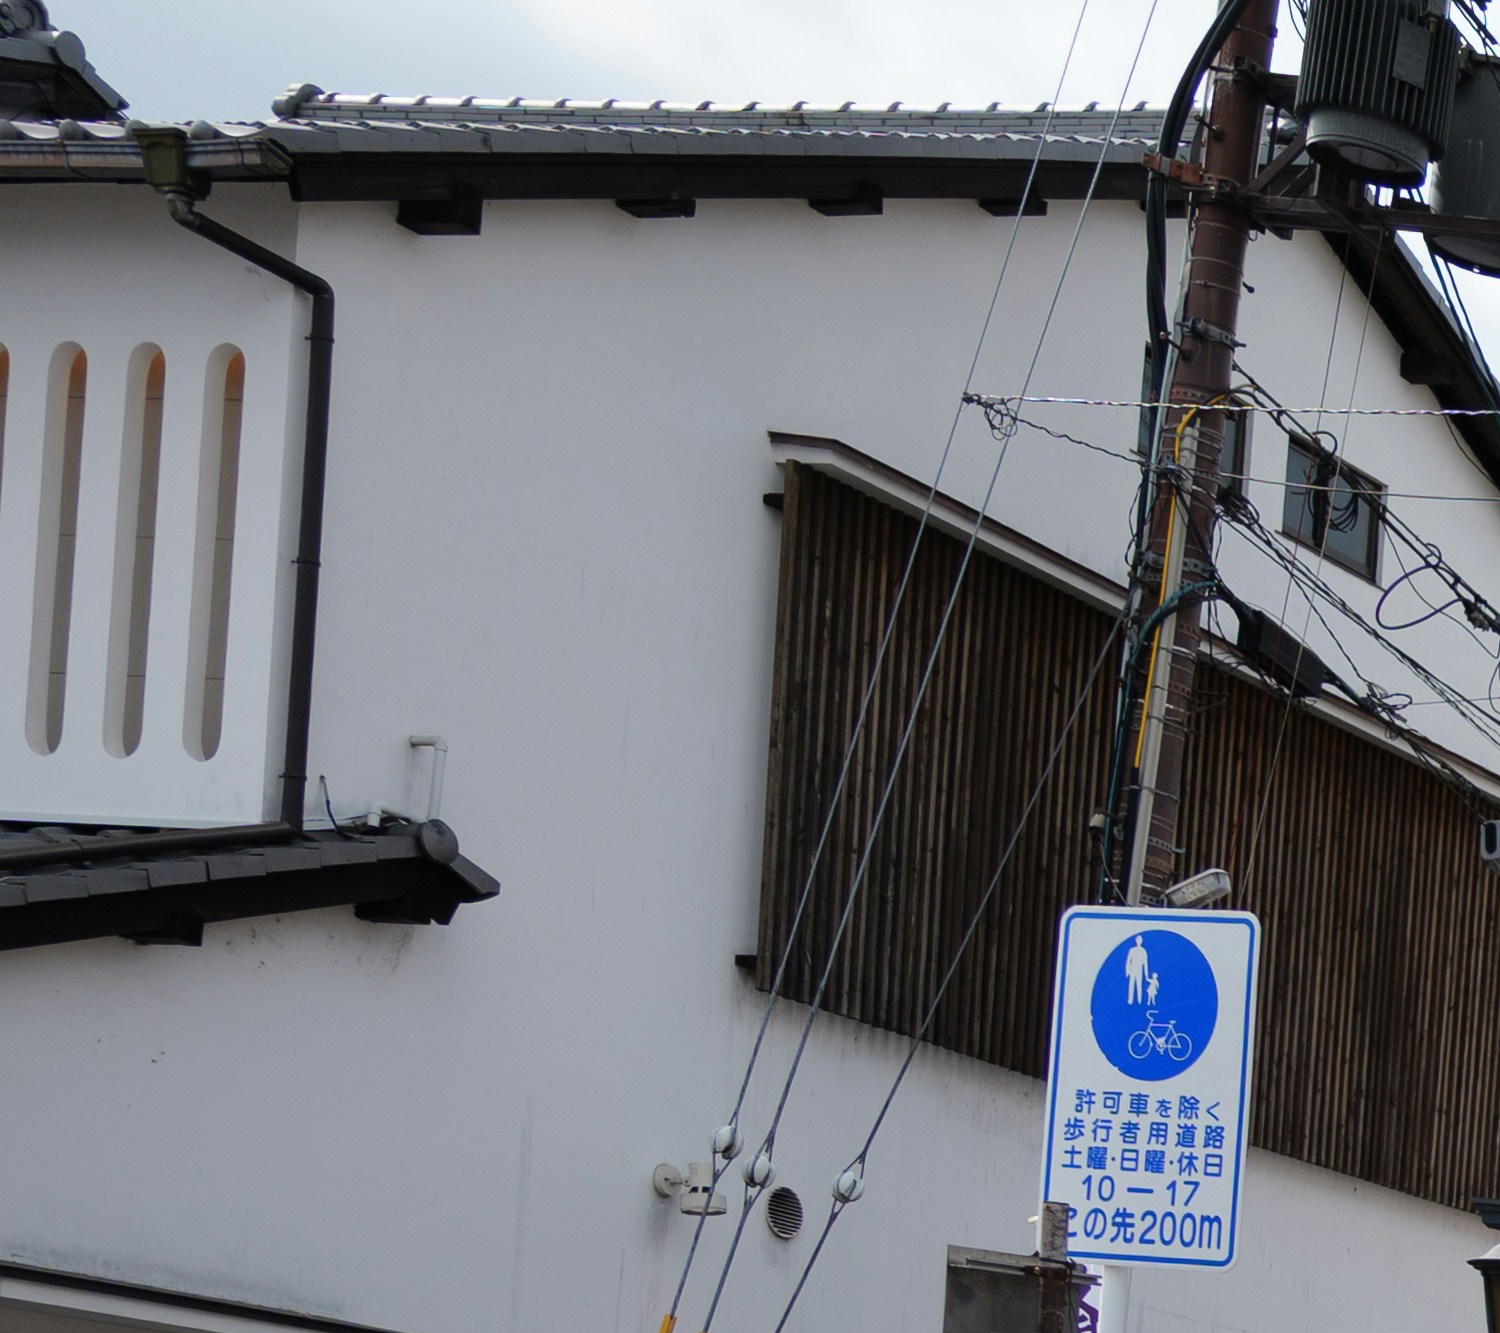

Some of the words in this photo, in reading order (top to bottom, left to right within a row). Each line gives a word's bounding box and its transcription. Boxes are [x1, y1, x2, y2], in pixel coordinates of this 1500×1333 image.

[1075, 1089, 1220, 1121] 許可車を除く
[1064, 1117, 1225, 1149] 歩行者用道路
